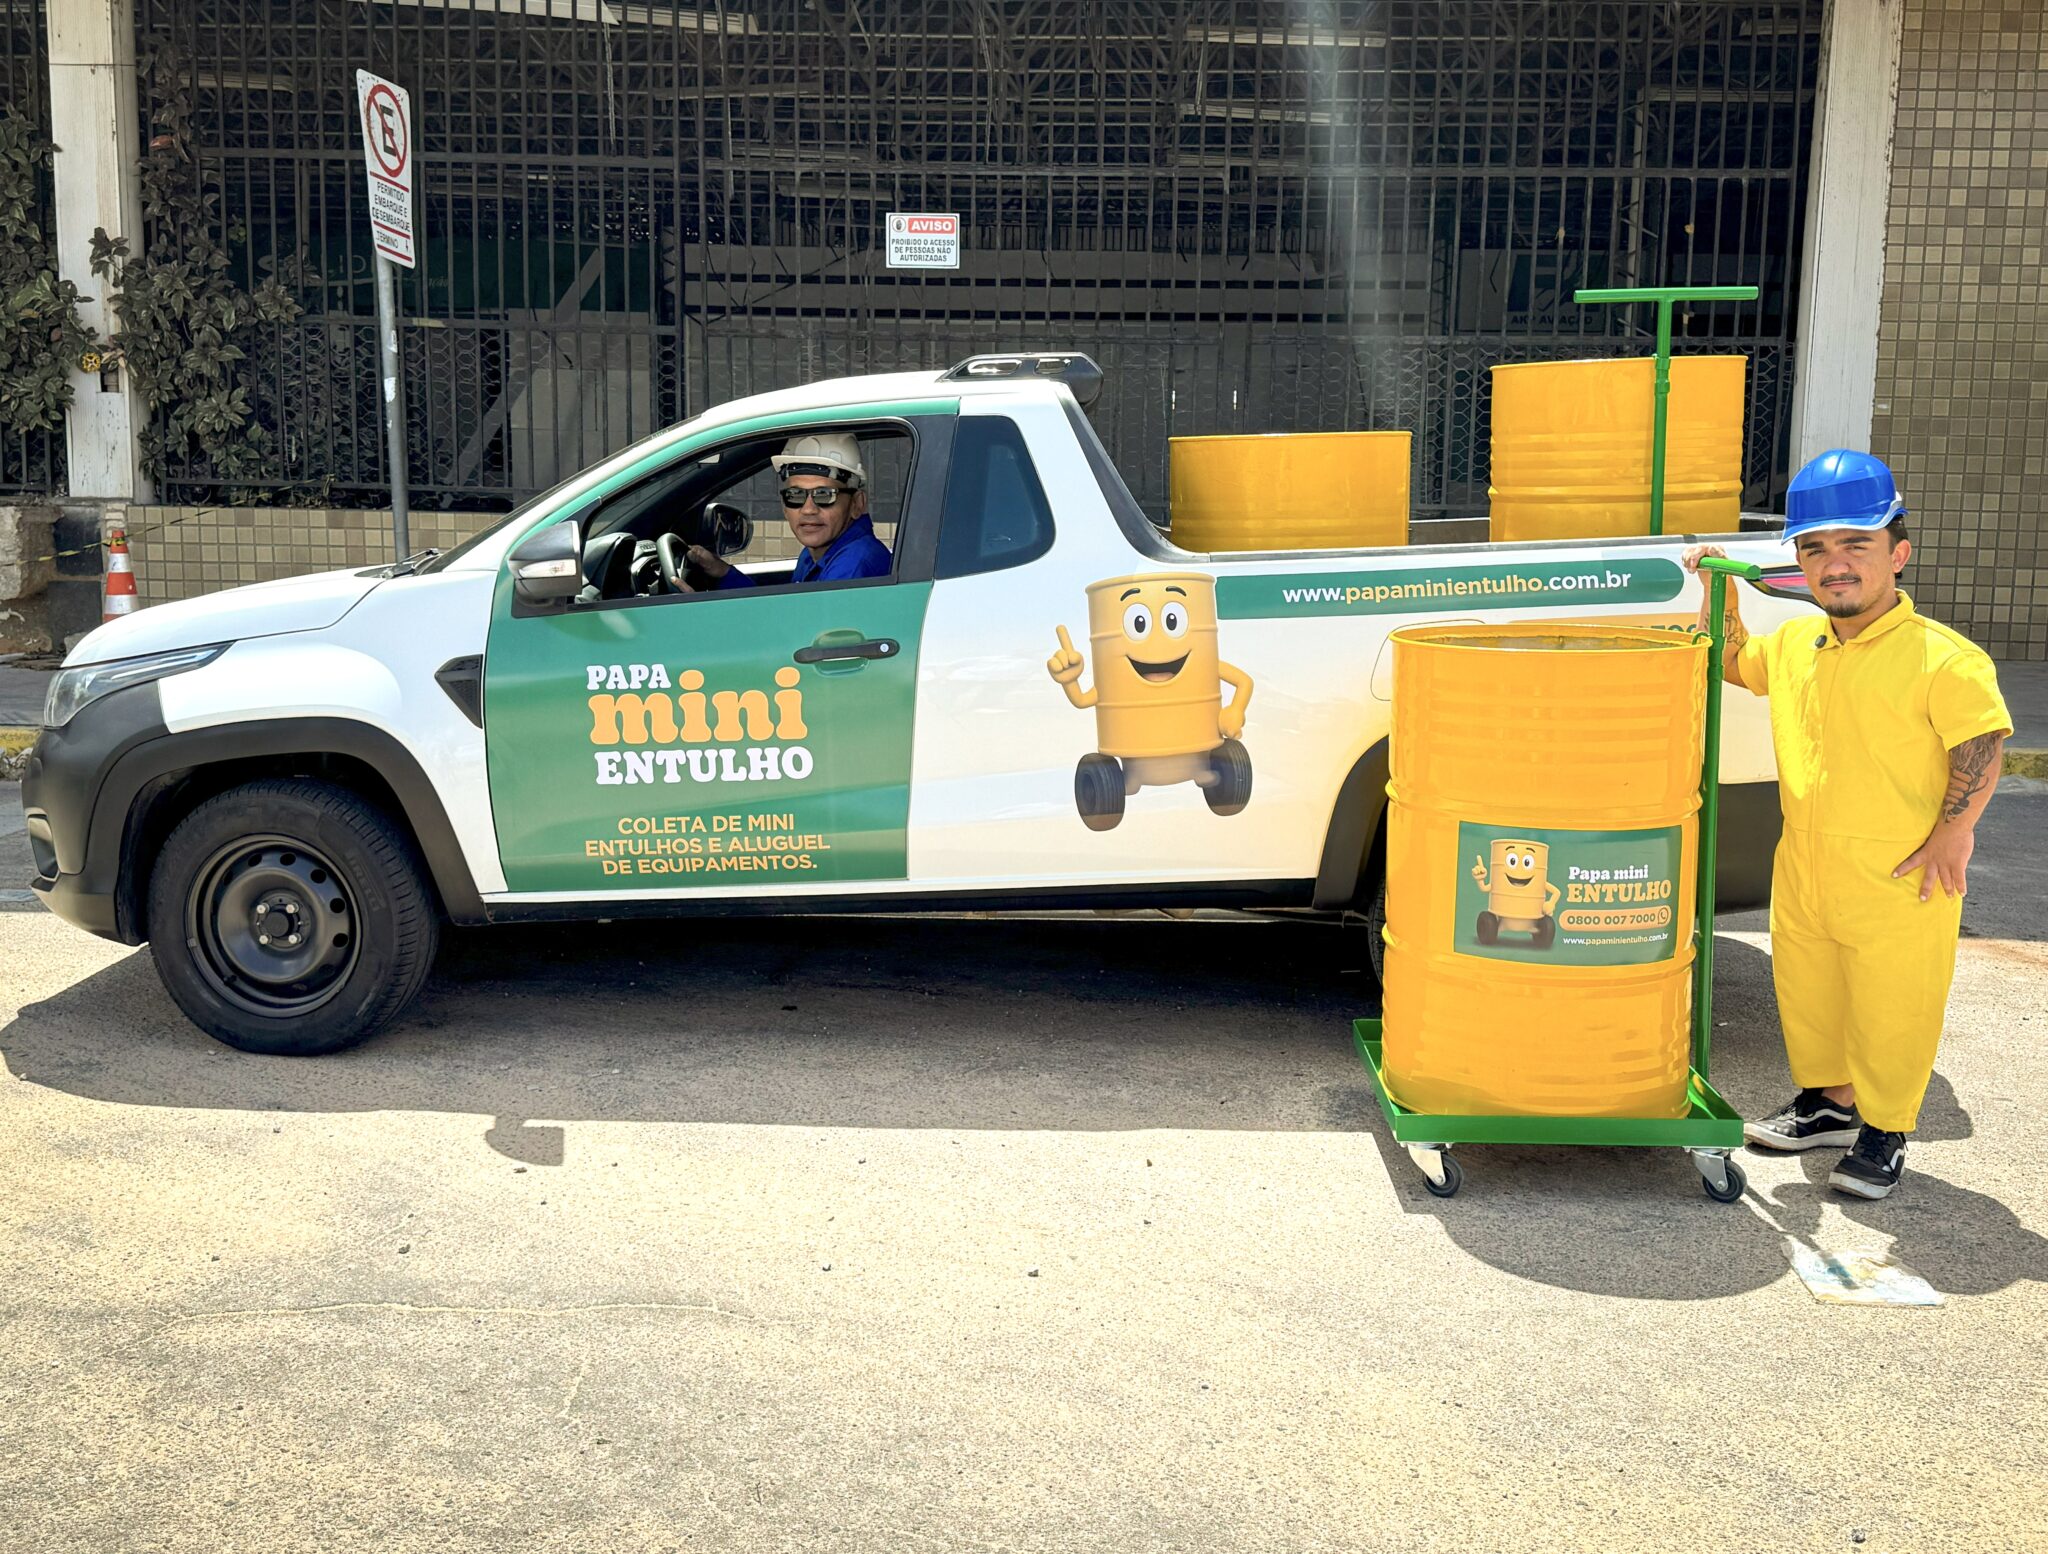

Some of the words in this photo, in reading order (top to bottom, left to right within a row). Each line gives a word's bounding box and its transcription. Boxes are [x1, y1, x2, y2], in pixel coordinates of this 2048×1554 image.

[377, 181, 405, 203] PERMITIDO
[374, 194, 403, 216] EMBARQUE
[372, 207, 411, 233] DESEMBARQUE
[911, 221, 953, 231] AVISO
[891, 238, 922, 246] PROIBIDO
[929, 239, 955, 247] ACESSO
[936, 246, 952, 254] NÃO
[900, 254, 947, 262] AUTORIZADAS
[1282, 570, 1631, 604] www.papaminientulho.com.br
[586, 663, 672, 690] PAPA
[588, 666, 808, 745] mini
[594, 746, 814, 785] ENTULHO
[617, 816, 707, 835] COLETA
[712, 814, 742, 833] DE
[748, 813, 795, 831] MINI
[585, 837, 703, 857] ENTULHOS
[708, 837, 722, 853] E
[728, 834, 831, 853] ALUGUEL
[602, 859, 632, 875] DE
[638, 854, 818, 875] EQUIPAMENTOS.
[1568, 866, 1610, 883] Papa
[1613, 864, 1649, 880] mini
[1566, 880, 1672, 903] ENTULHO
[1567, 915, 1600, 926] 0800
[1604, 915, 1627, 925] 007
[1629, 913, 1656, 925] 7000
[1563, 932, 1669, 946] www.papaminientulho.com.br
